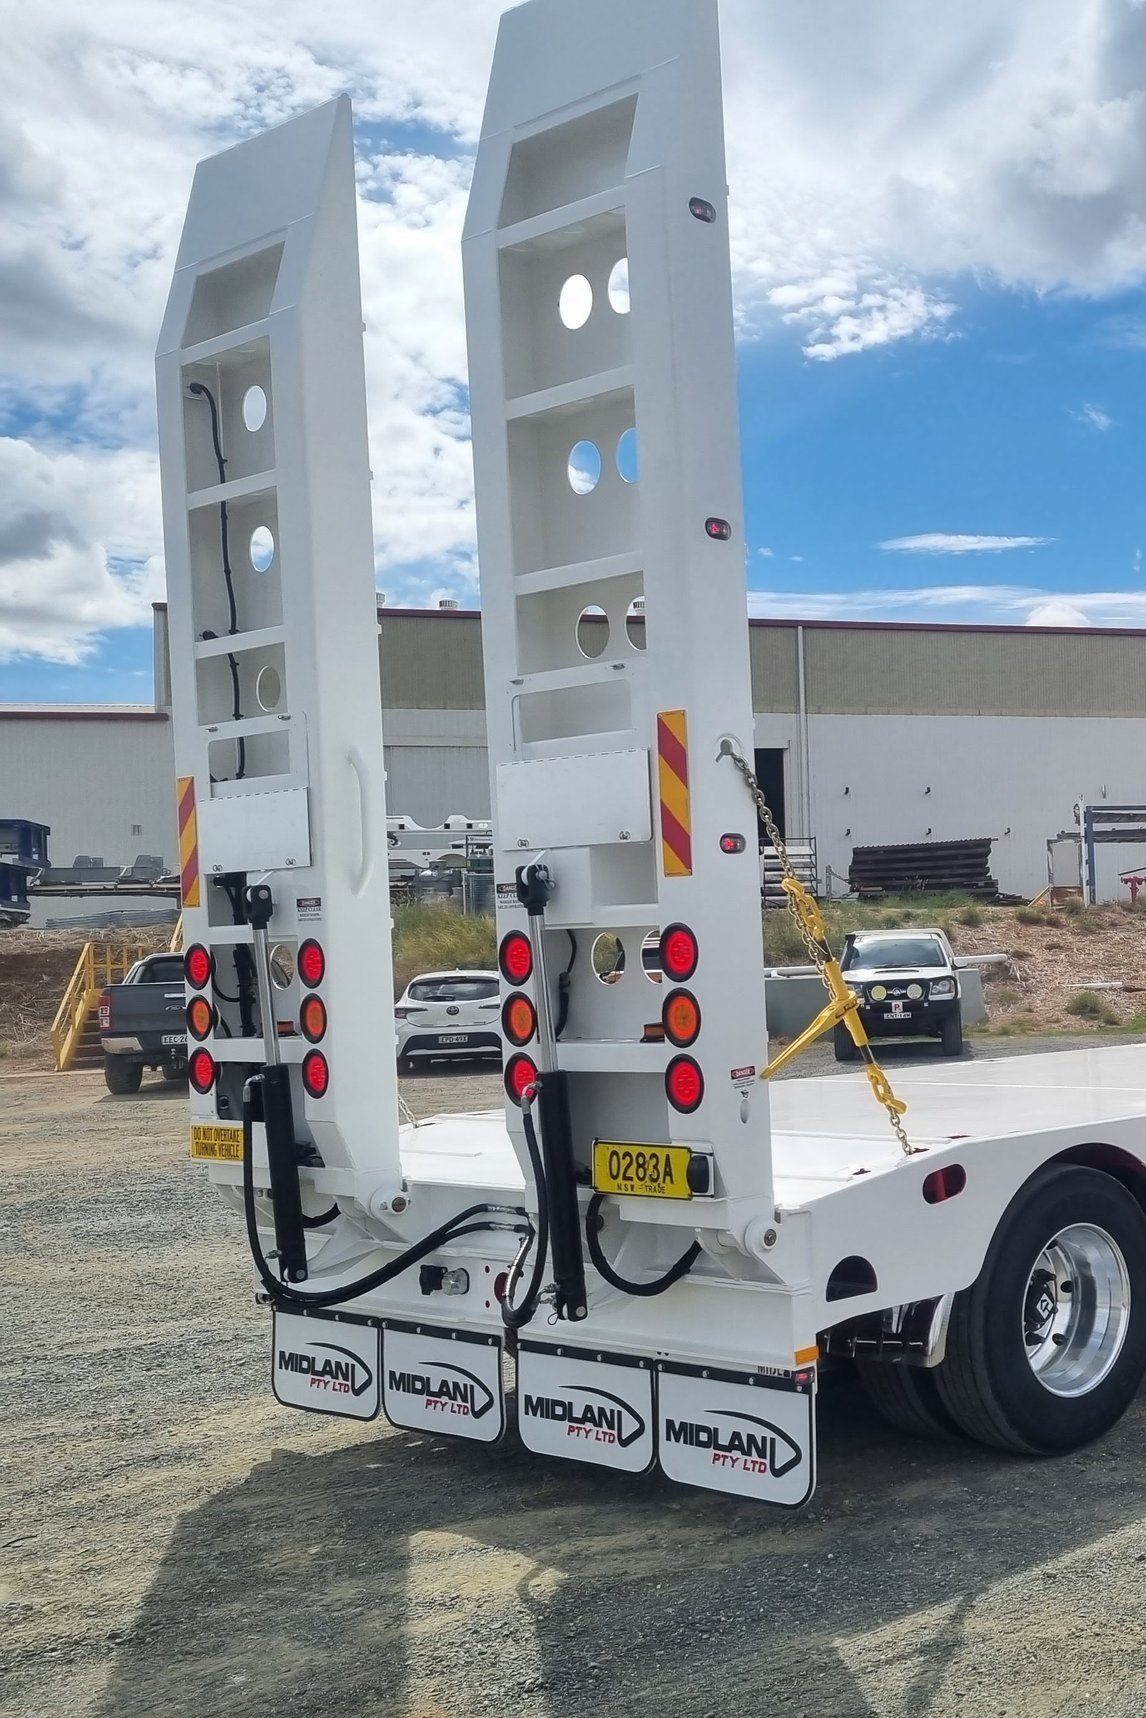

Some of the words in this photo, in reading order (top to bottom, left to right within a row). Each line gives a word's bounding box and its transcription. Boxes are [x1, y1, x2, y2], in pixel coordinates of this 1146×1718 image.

[193, 1127, 202, 1140] DO
[202, 1128, 213, 1141] NOT
[213, 1128, 240, 1143] OVERTAKE
[195, 1141, 217, 1156] TURNING
[218, 1143, 240, 1157] VEHICLE
[608, 1149, 675, 1185] 0283A
[310, 1377, 331, 1390] PTY
[332, 1382, 350, 1393] LTD
[425, 1398, 448, 1412] PTY
[450, 1403, 470, 1416] LTD
[567, 1424, 592, 1439] PTY
[594, 1430, 616, 1444] LTD
[712, 1452, 739, 1469] PTY
[742, 1458, 767, 1474] LTD
